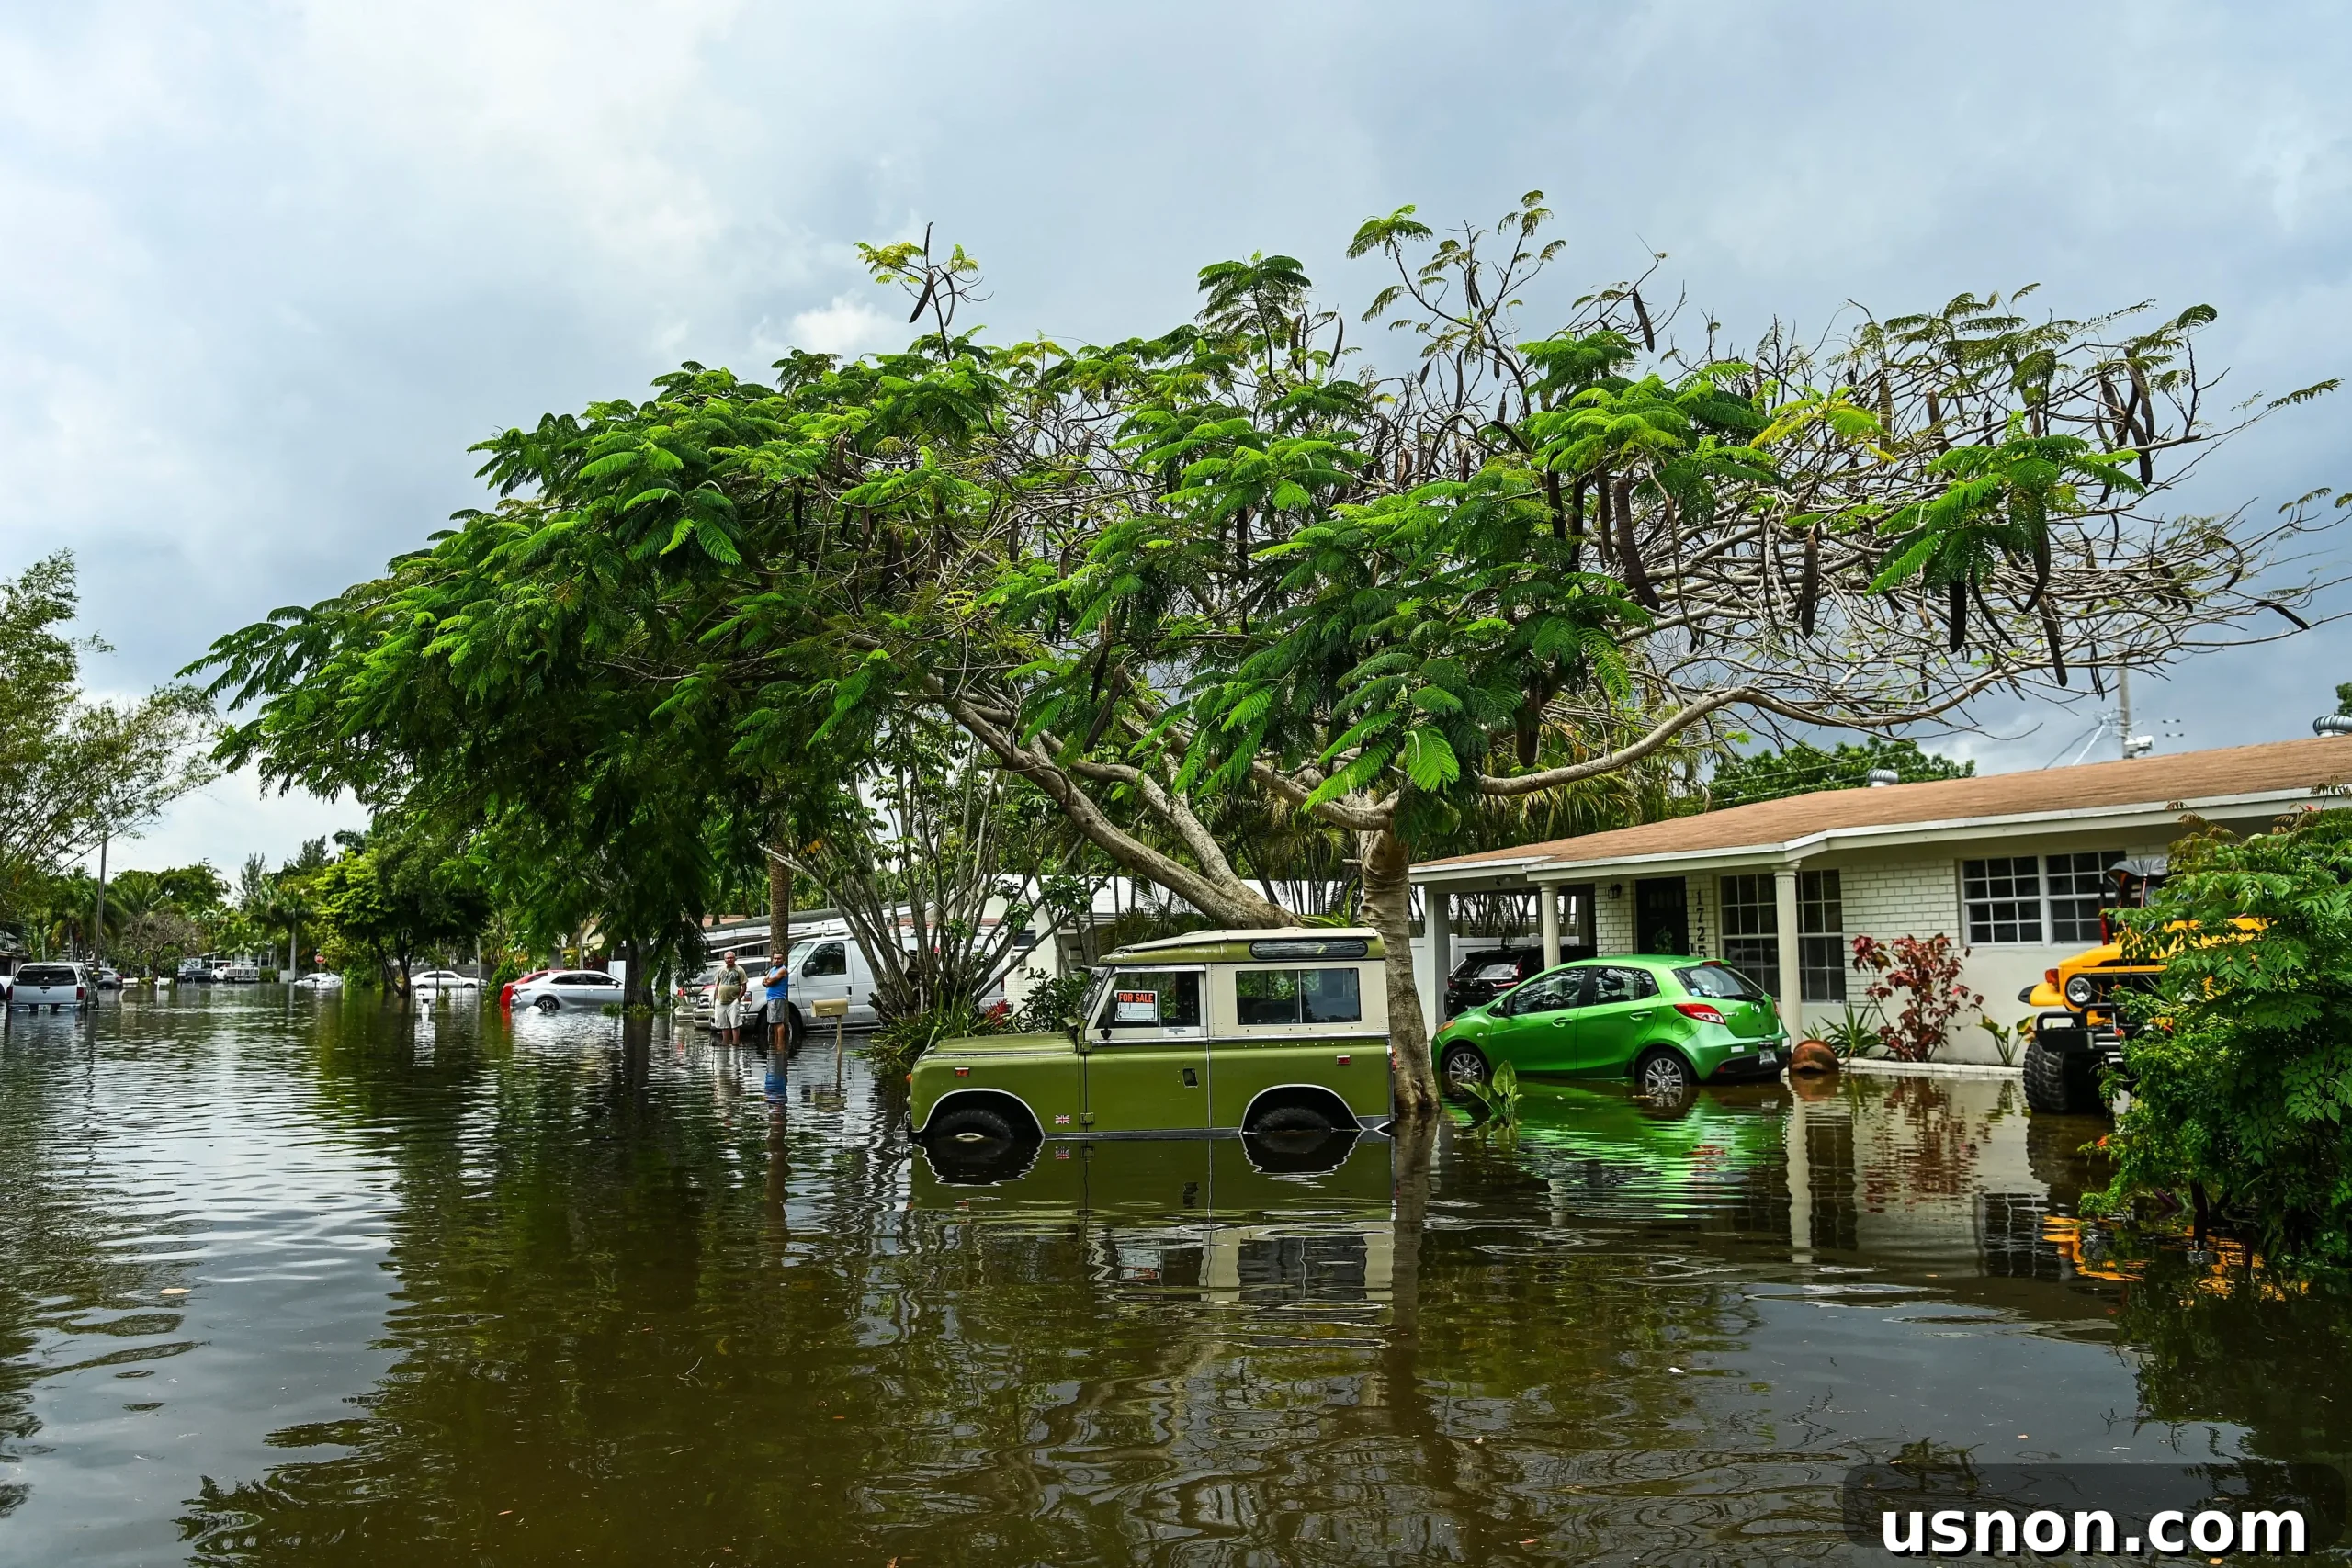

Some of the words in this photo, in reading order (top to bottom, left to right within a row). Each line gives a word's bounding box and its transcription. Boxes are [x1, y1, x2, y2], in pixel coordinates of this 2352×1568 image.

[1696, 889, 1707, 958] 1725
[1118, 993, 1133, 1002] FOR
[1135, 993, 1154, 1003] SALE
